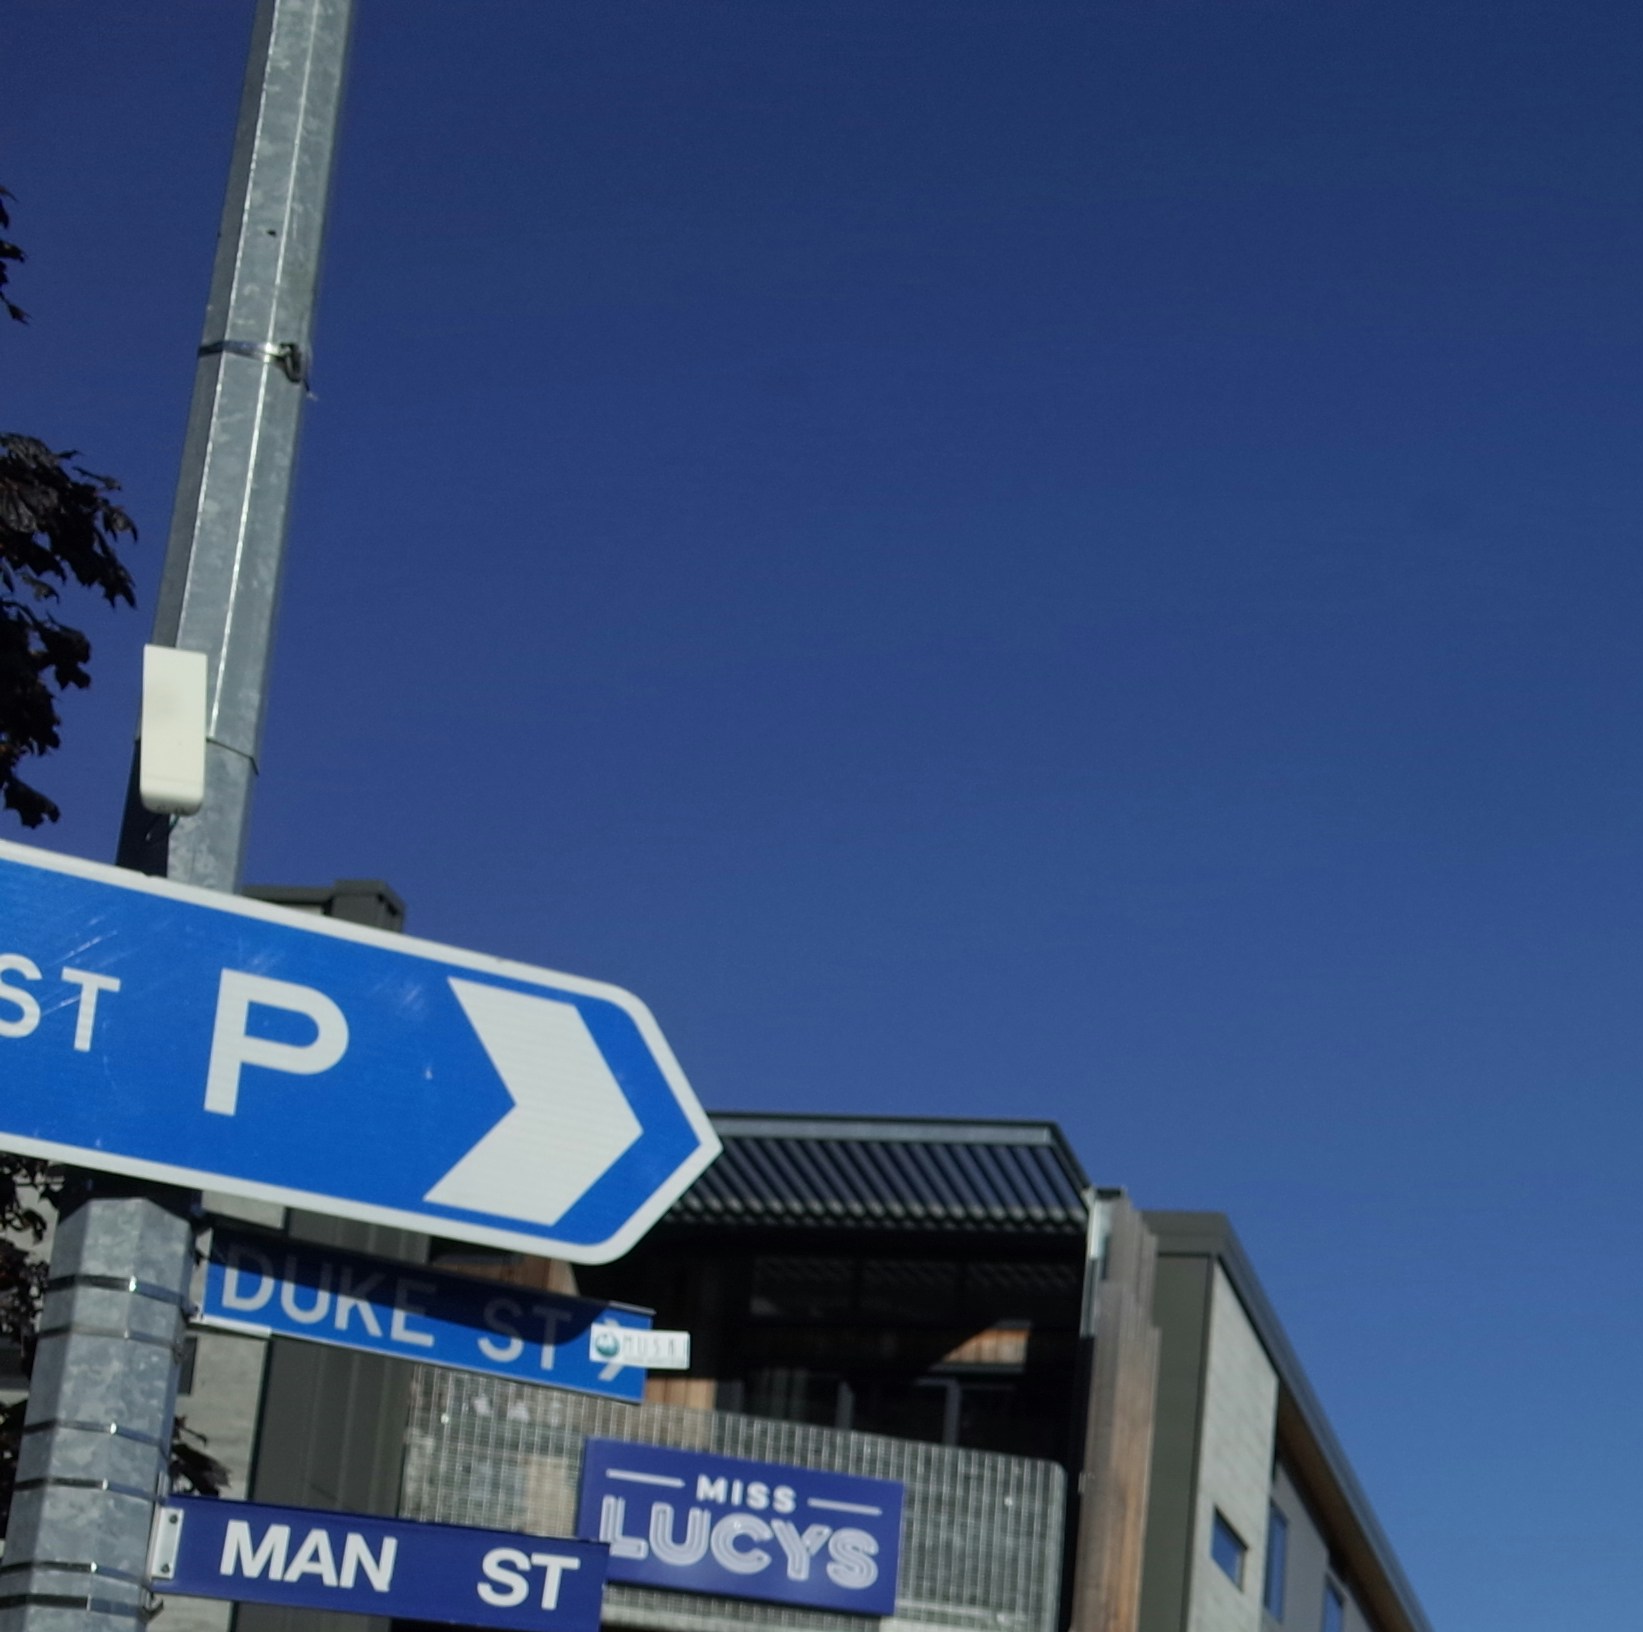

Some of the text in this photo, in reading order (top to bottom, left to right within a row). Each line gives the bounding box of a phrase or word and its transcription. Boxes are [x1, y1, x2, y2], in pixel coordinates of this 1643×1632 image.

[0, 953, 349, 1116] ST P
[222, 1244, 573, 1370] DUKE ST
[696, 1474, 796, 1513] MISS
[220, 1520, 580, 1610] MAN ST
[599, 1494, 879, 1589] LUCYS
